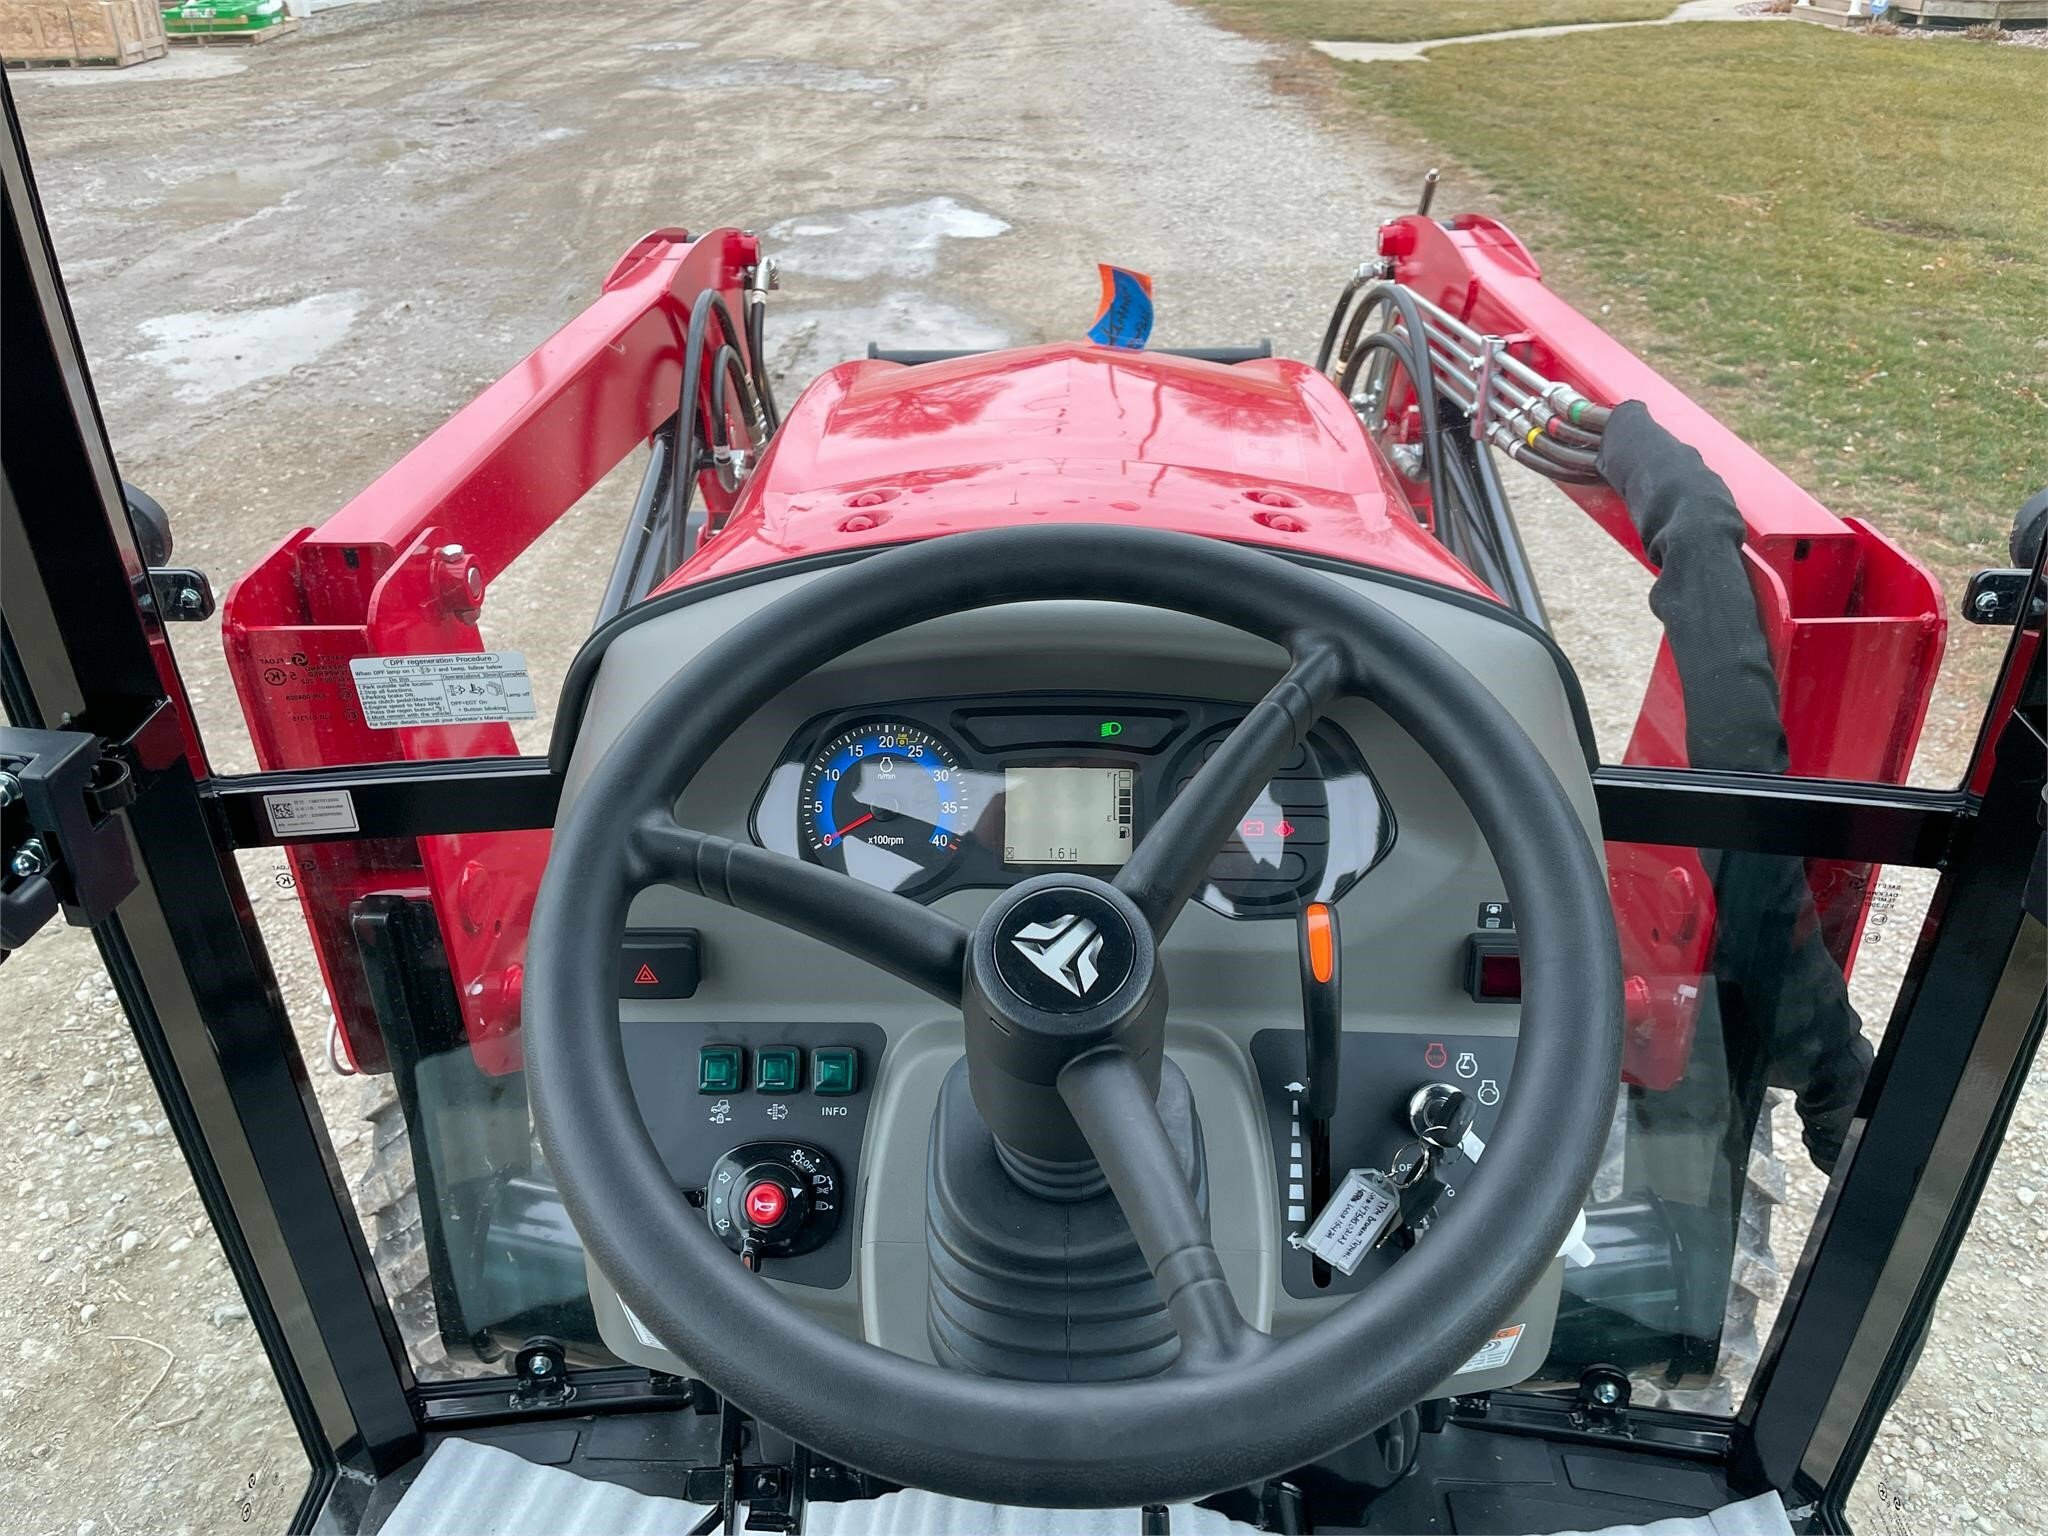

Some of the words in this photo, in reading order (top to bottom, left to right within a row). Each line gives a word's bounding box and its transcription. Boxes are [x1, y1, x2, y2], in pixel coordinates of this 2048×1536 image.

[407, 657, 453, 667] regeneration
[456, 655, 492, 663] Procedure
[878, 735, 895, 748] 20
[848, 745, 863, 757] 15
[907, 745, 923, 758] 25
[824, 768, 840, 781] 10
[933, 769, 949, 782] 30
[814, 800, 823, 813] 5
[942, 801, 957, 814] 35
[823, 834, 832, 846] 0
[868, 836, 904, 846] x100rpm
[932, 834, 948, 847] 40
[1049, 847, 1065, 859] 1.6
[1069, 847, 1077, 859] H
[821, 1106, 848, 1116] INFO
[803, 1159, 817, 1174] OFF
[1398, 1163, 1413, 1172] OF
